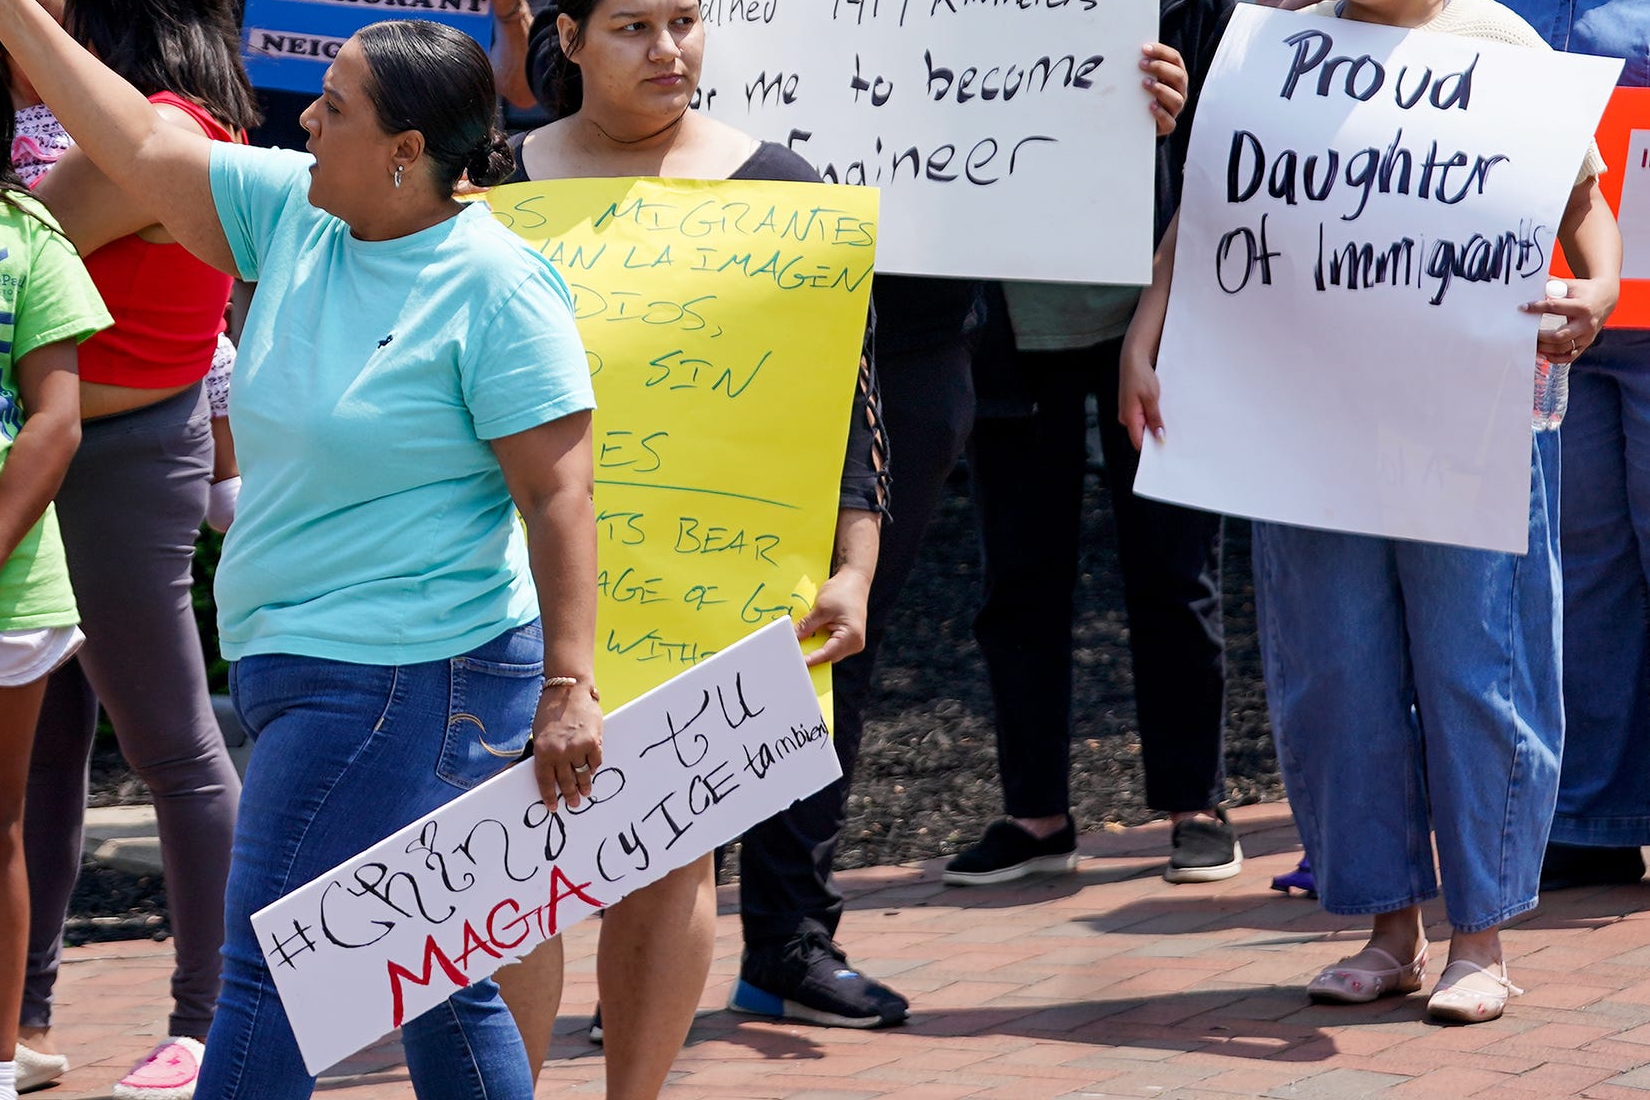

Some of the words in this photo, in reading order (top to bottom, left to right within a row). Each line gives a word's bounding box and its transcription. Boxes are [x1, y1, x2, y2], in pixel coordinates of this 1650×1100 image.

[260, 33, 341, 57] NEIG
[690, 85, 717, 111] or
[745, 71, 800, 114] me
[850, 53, 894, 107] to
[924, 49, 1105, 104] become
[1280, 29, 1480, 111] Proud
[1227, 127, 1511, 220] Daughter
[594, 198, 876, 247] MIGRANTES
[624, 245, 674, 268] LA
[690, 249, 876, 293] IMAGEN
[646, 350, 773, 399] SIN
[600, 431, 669, 472] ES
[596, 511, 646, 545] TS
[674, 516, 780, 568] BEAR
[597, 568, 674, 604] AGE
[606, 628, 717, 664] WITH
[386, 865, 607, 1028] MAGA
